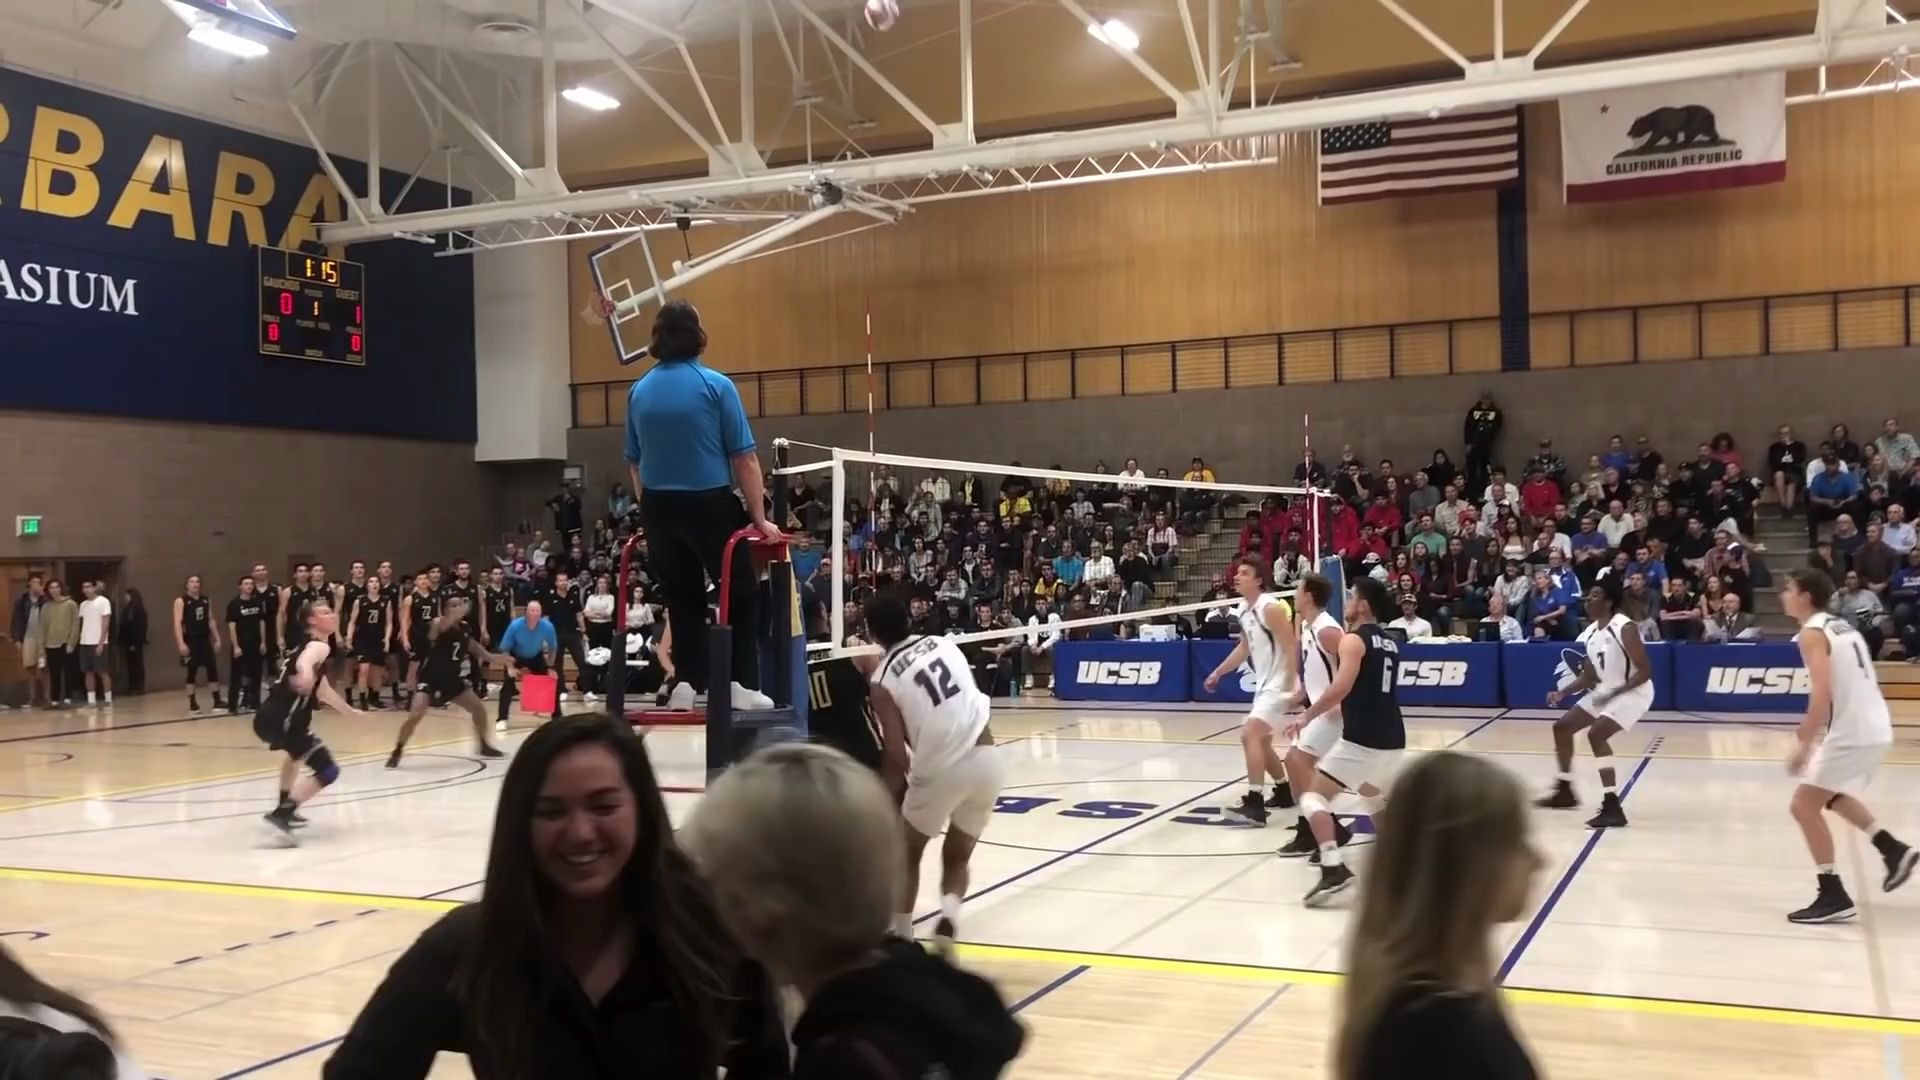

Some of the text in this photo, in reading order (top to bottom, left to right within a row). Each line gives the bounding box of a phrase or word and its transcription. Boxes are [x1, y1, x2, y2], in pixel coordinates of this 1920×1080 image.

[1606, 149, 1743, 176] CALIFORNIA REPUBLIC
[0, 102, 346, 262] BARA
[280, 292, 293, 315] 0
[268, 323, 279, 341] 0
[351, 335, 361, 352] 0
[890, 637, 939, 678] UCSB
[913, 656, 961, 707] 12
[1076, 661, 1162, 686] UCSB
[1396, 661, 1468, 686] CSB
